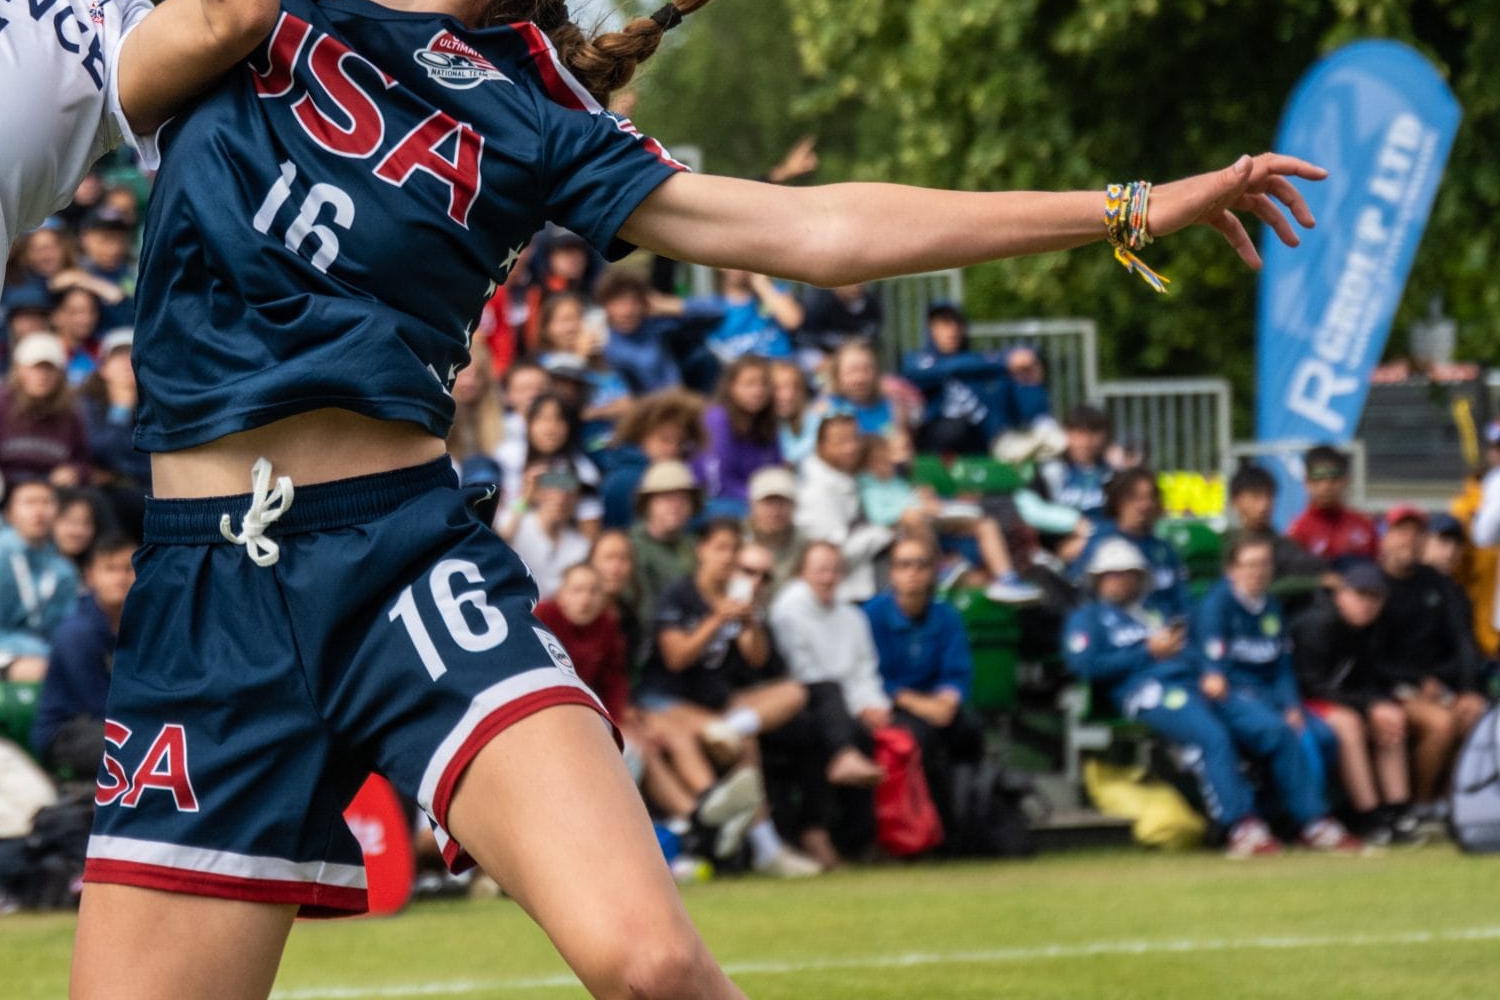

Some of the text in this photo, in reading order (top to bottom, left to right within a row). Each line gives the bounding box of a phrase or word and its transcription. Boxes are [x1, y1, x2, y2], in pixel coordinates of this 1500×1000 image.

[431, 68, 466, 78] NATIONAL
[439, 37, 483, 59] ULTIMA
[253, 159, 355, 275] 16
[389, 559, 509, 682] 16
